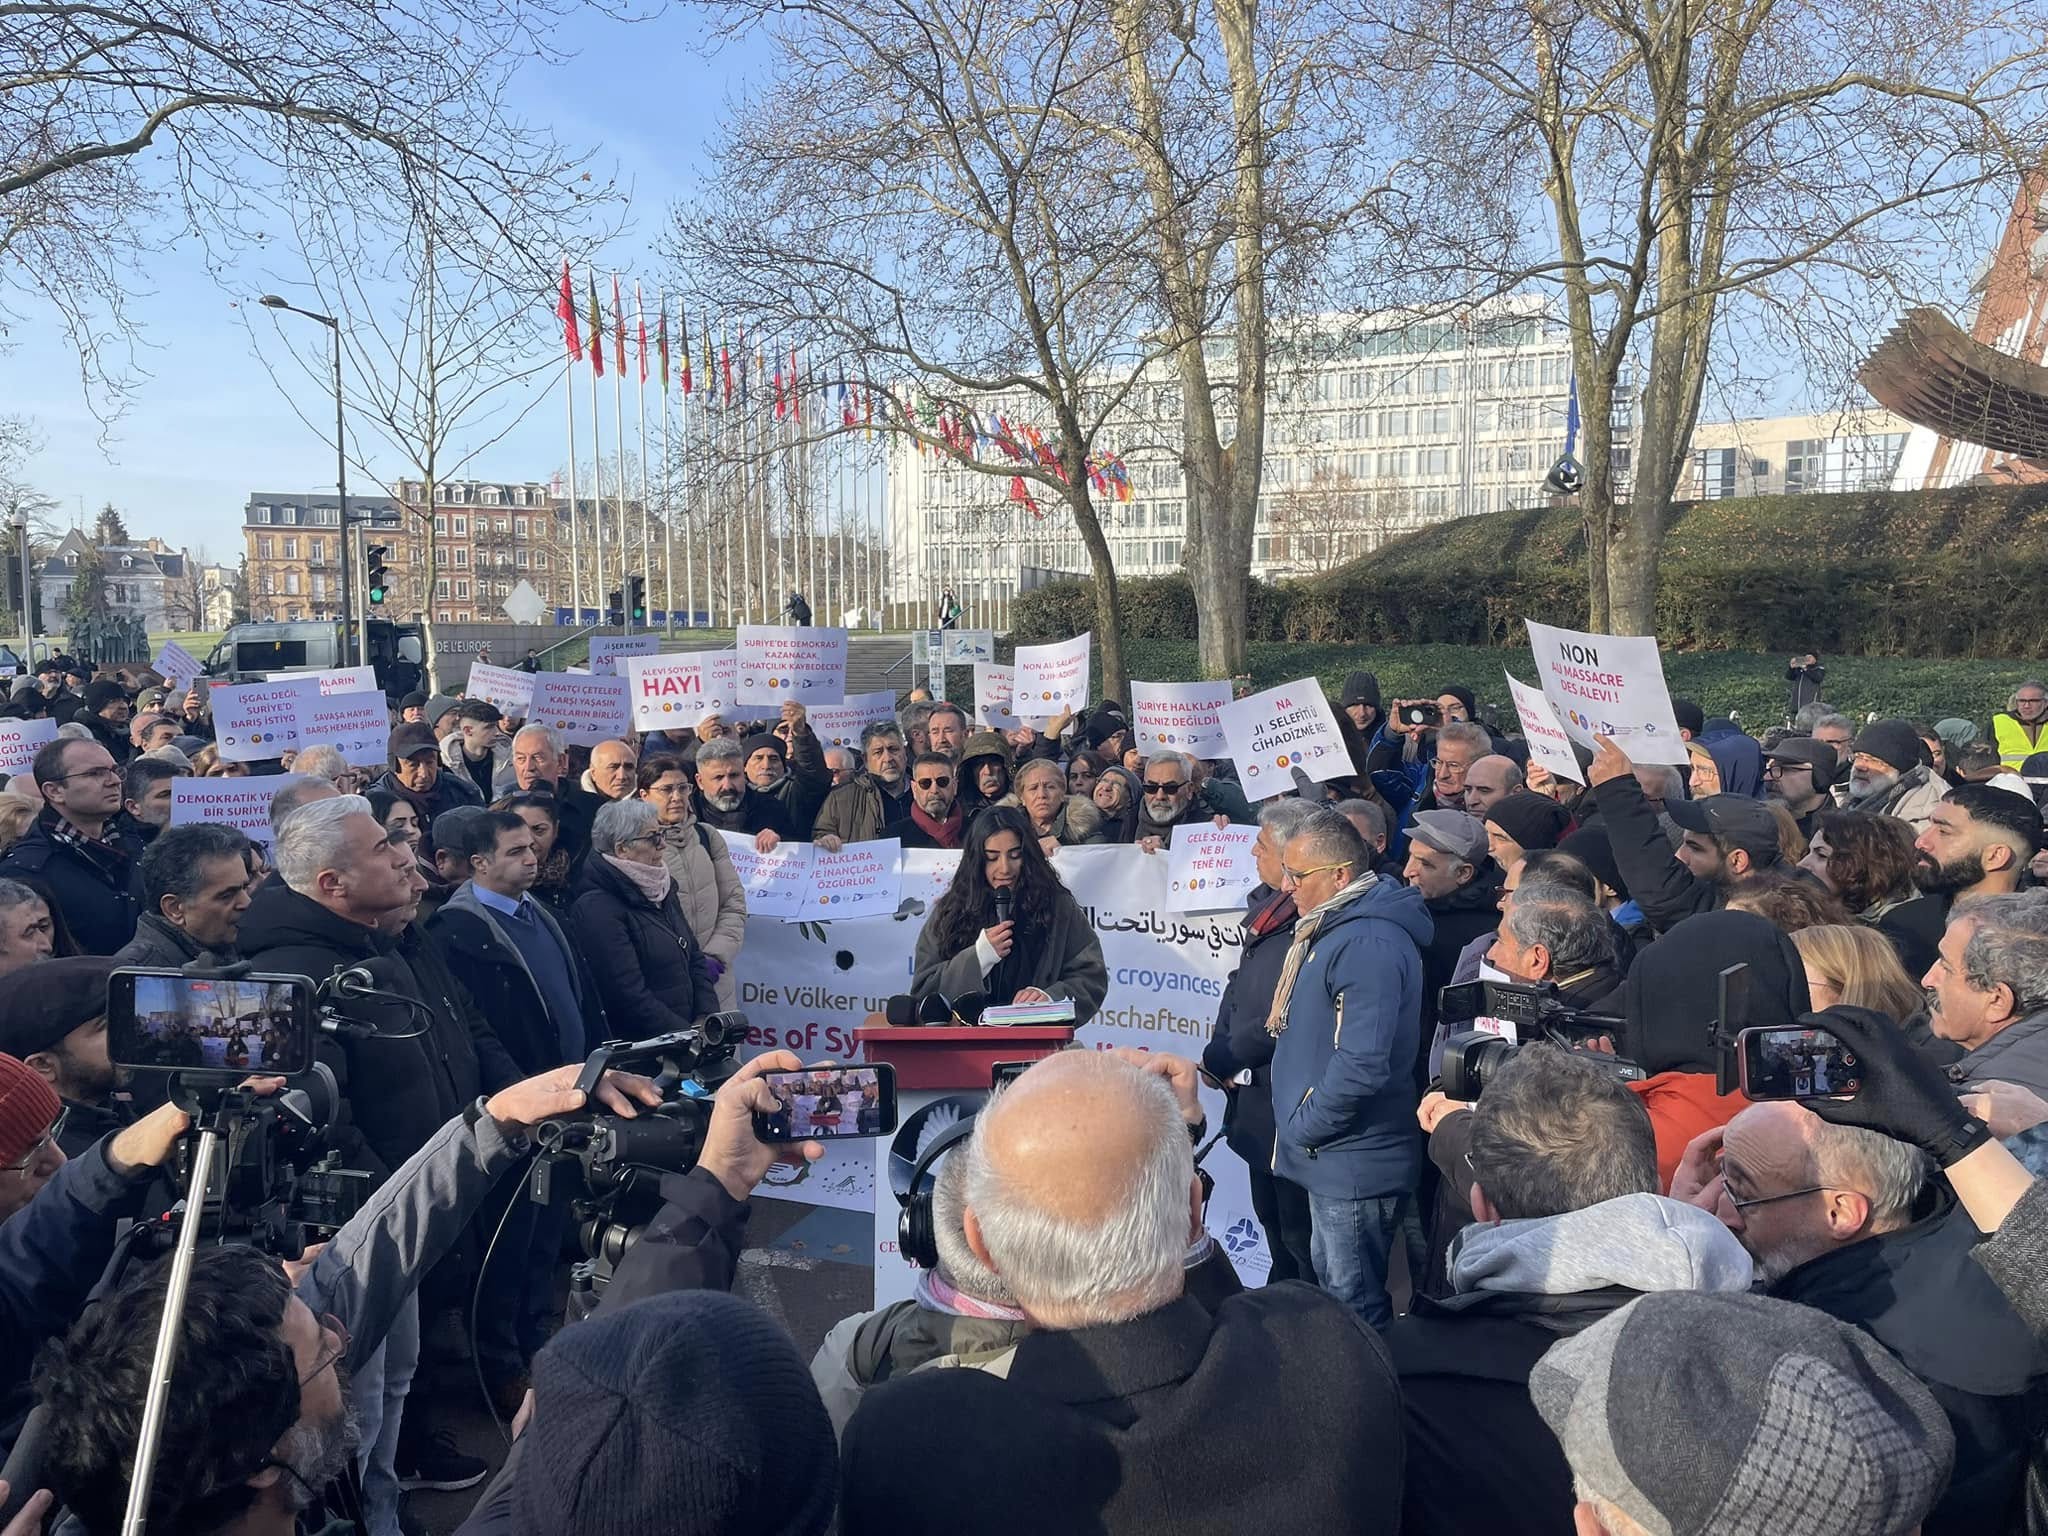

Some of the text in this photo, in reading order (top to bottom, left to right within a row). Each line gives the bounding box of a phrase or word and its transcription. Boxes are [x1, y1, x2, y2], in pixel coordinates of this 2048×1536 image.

[436, 640, 492, 652] DE L'EUROPE
[1559, 642, 1599, 667] NON
[669, 665, 701, 675] SOYKIRI
[1023, 663, 1041, 671] NON
[1552, 662, 1624, 687] AU MASSACRE
[643, 676, 700, 697] HAYI
[1561, 679, 1578, 695] DES
[1580, 686, 1612, 703] ALEVI
[247, 702, 292, 715] SURİYE'D
[1276, 698, 1293, 711] NA
[231, 714, 296, 729] BARIŞ İSTİYO
[314, 711, 346, 722] SAVAŞA
[1138, 715, 1169, 726] YALNIZ
[305, 725, 330, 735] BARIŞ
[330, 722, 359, 732] HEMEN
[825, 721, 840, 729] DES
[177, 791, 273, 804] DEMOKRATİK VE
[203, 805, 224, 817] BİR
[226, 805, 265, 816] SURİYE
[1200, 846, 1213, 855] NE
[767, 858, 780, 867] DE
[781, 860, 807, 869] SYRIE
[818, 851, 873, 866] HALKLARA
[1216, 858, 1233, 868] NE!
[750, 868, 767, 877] PAS
[769, 870, 800, 880] SEULS!
[823, 863, 884, 877] İNANÇLARA
[817, 876, 876, 890] ÖZGÜRLÜK!
[1116, 967, 1221, 997] croyances
[742, 982, 888, 1012] Die Völker un
[785, 1023, 819, 1051] of
[1619, 1068, 1633, 1077] JVC
